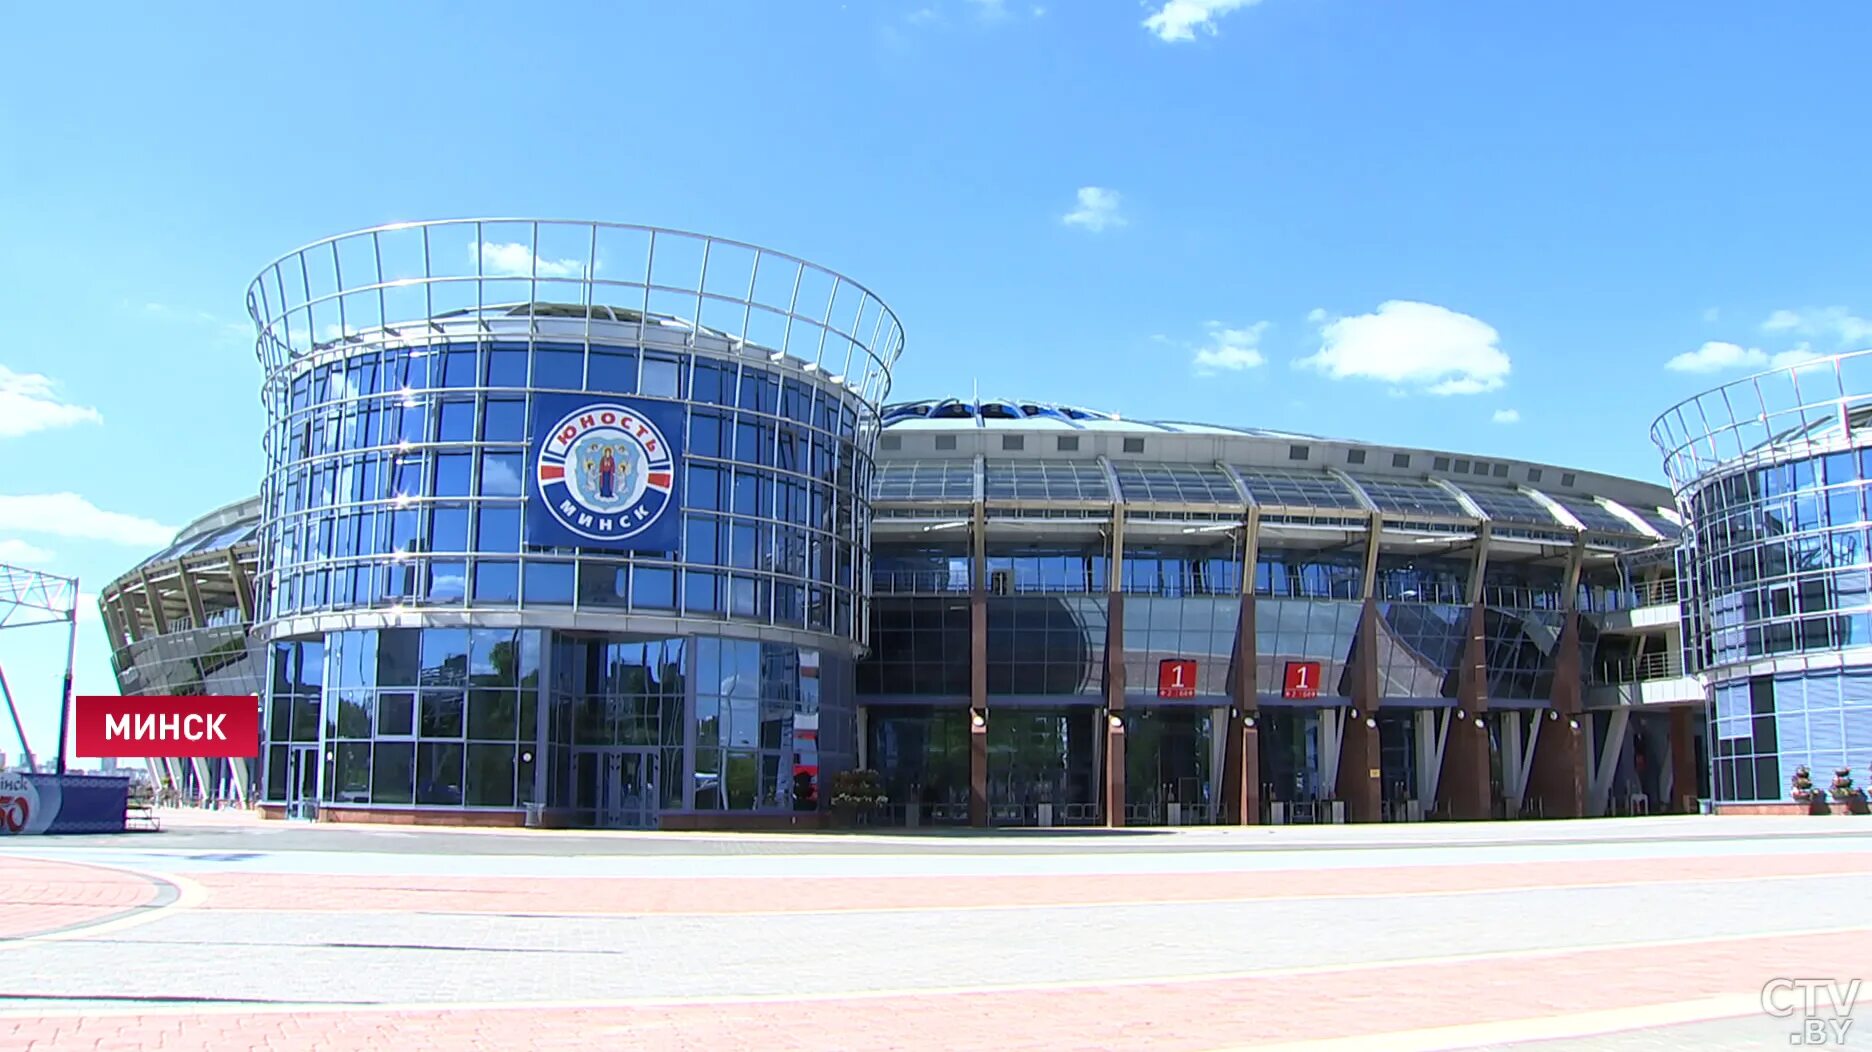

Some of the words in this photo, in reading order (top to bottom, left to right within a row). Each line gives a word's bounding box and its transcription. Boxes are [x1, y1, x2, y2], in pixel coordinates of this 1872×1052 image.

[556, 412, 657, 452] ЮНОСТЬ
[559, 499, 649, 531] МИНСК
[1171, 664, 1184, 688] 1
[1295, 666, 1308, 689] 1
